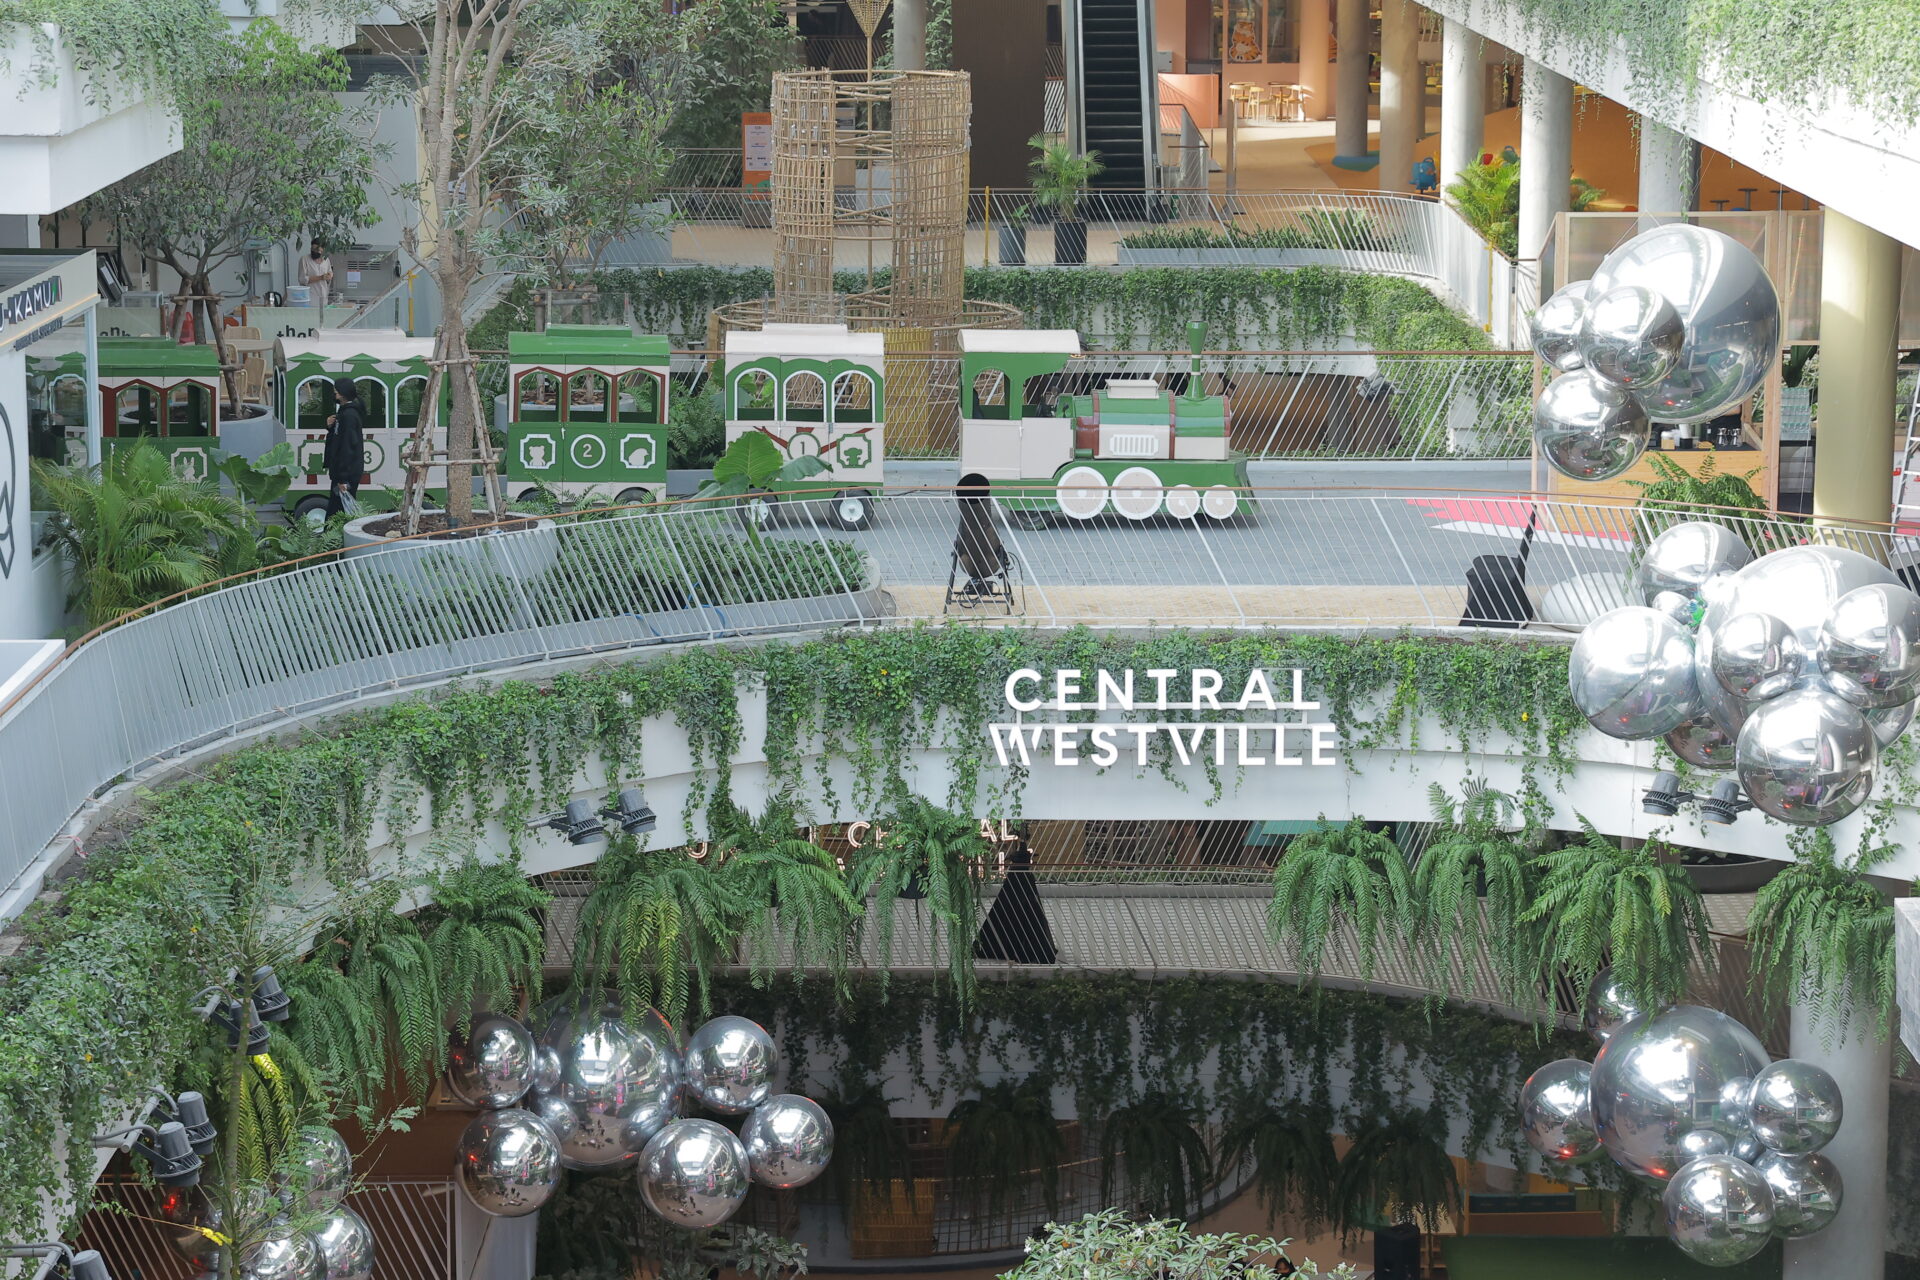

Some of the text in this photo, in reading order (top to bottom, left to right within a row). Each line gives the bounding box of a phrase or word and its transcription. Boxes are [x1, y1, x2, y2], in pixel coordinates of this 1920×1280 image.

[583, 443, 593, 458] 2
[800, 441, 805, 455] 1
[363, 451, 372, 465] 3
[1005, 668, 1320, 712] CENTRAL
[988, 723, 1336, 766] WESTVILLE
